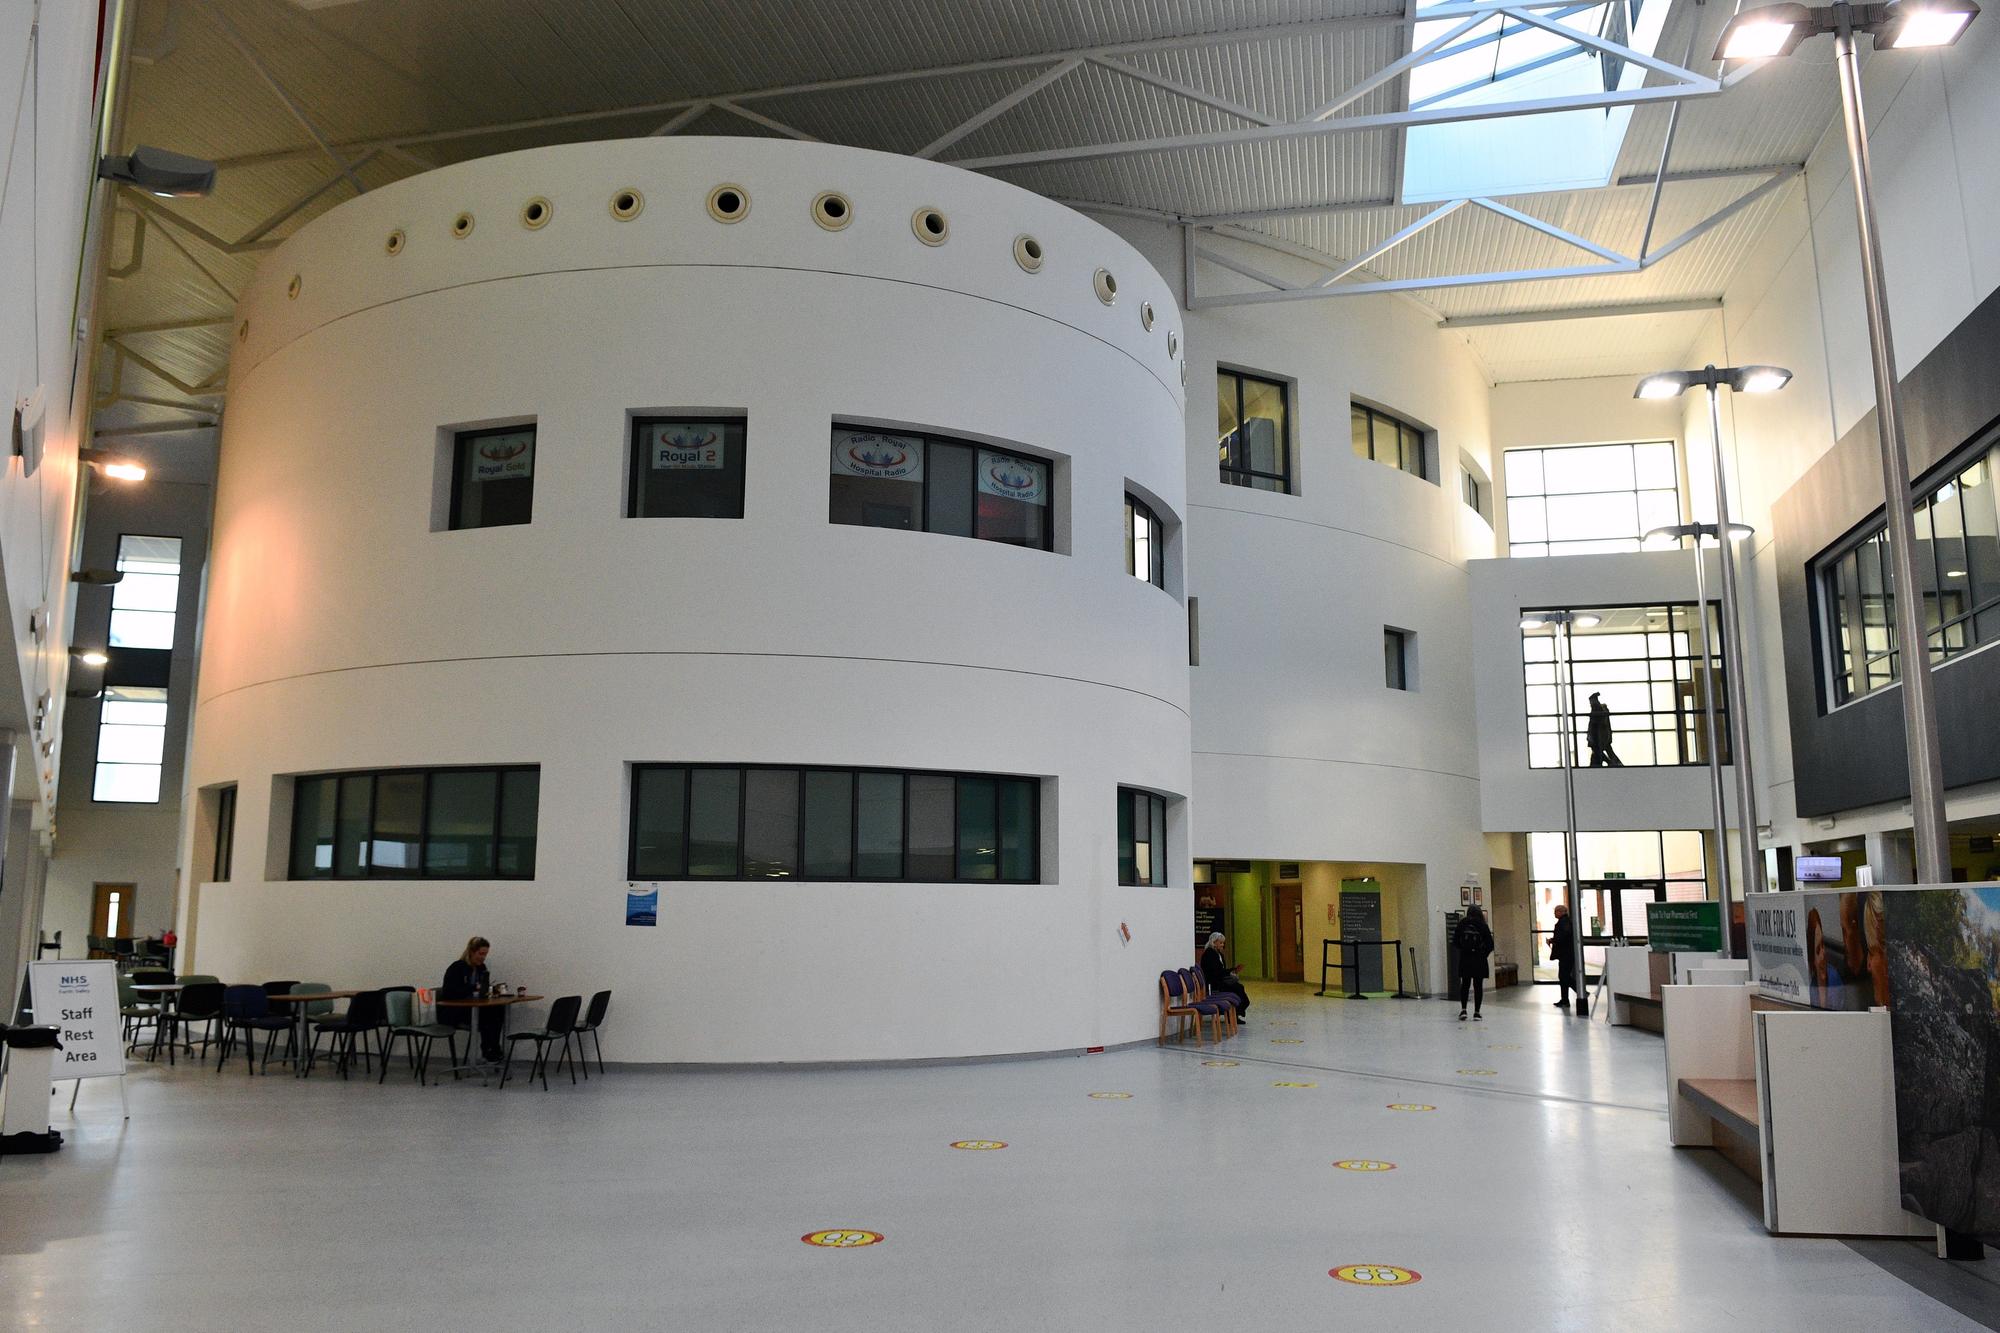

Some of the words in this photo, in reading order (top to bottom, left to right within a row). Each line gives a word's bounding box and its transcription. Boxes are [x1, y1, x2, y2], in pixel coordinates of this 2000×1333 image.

[851, 434, 876, 444] Radio
[882, 435, 906, 449] Royal
[660, 450, 700, 464] Royal
[706, 450, 716, 462] 2
[478, 464, 503, 475] Royal
[850, 462, 882, 476] Hospital
[884, 468, 906, 477] Radio
[991, 481, 1016, 497] Hospital
[1017, 490, 1034, 498] Radio
[1754, 909, 1773, 937] WORK
[1772, 909, 1785, 937] FOR
[1784, 909, 1797, 938] US!
[61, 975, 87, 984] NHS
[61, 1007, 93, 1021] Staff
[65, 1030, 94, 1041] Rest
[65, 1051, 97, 1063] Area
